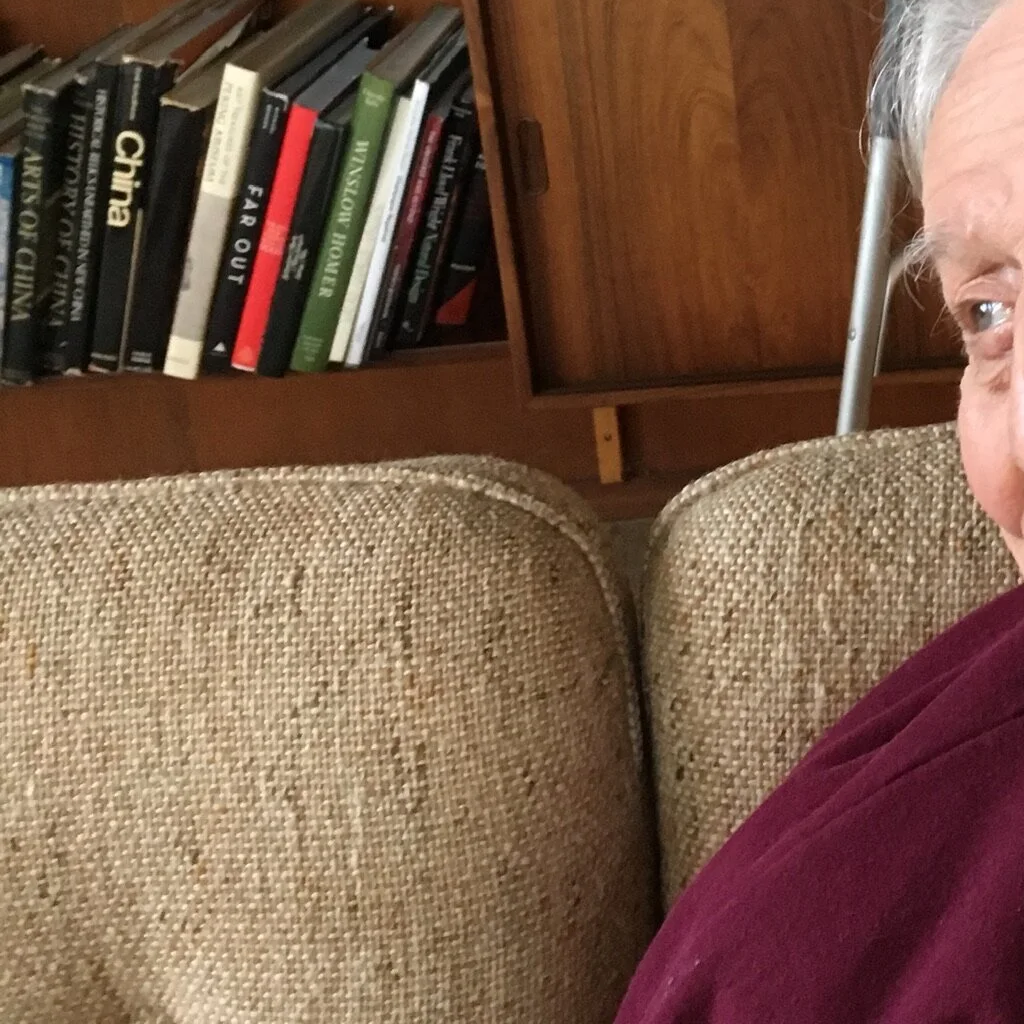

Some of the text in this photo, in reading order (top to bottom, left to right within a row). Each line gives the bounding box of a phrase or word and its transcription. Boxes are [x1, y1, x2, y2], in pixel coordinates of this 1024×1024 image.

[21, 146, 44, 204] ARTS
[61, 114, 87, 217] HISTORY
[107, 130, 146, 227] China
[18, 209, 39, 243] OF
[59, 218, 76, 252] OF
[227, 184, 264, 285] FAR OUT
[318, 140, 370, 298] WINSLOW HOMER
[9, 247, 38, 321] CHINA
[48, 255, 71, 326] CHINA
